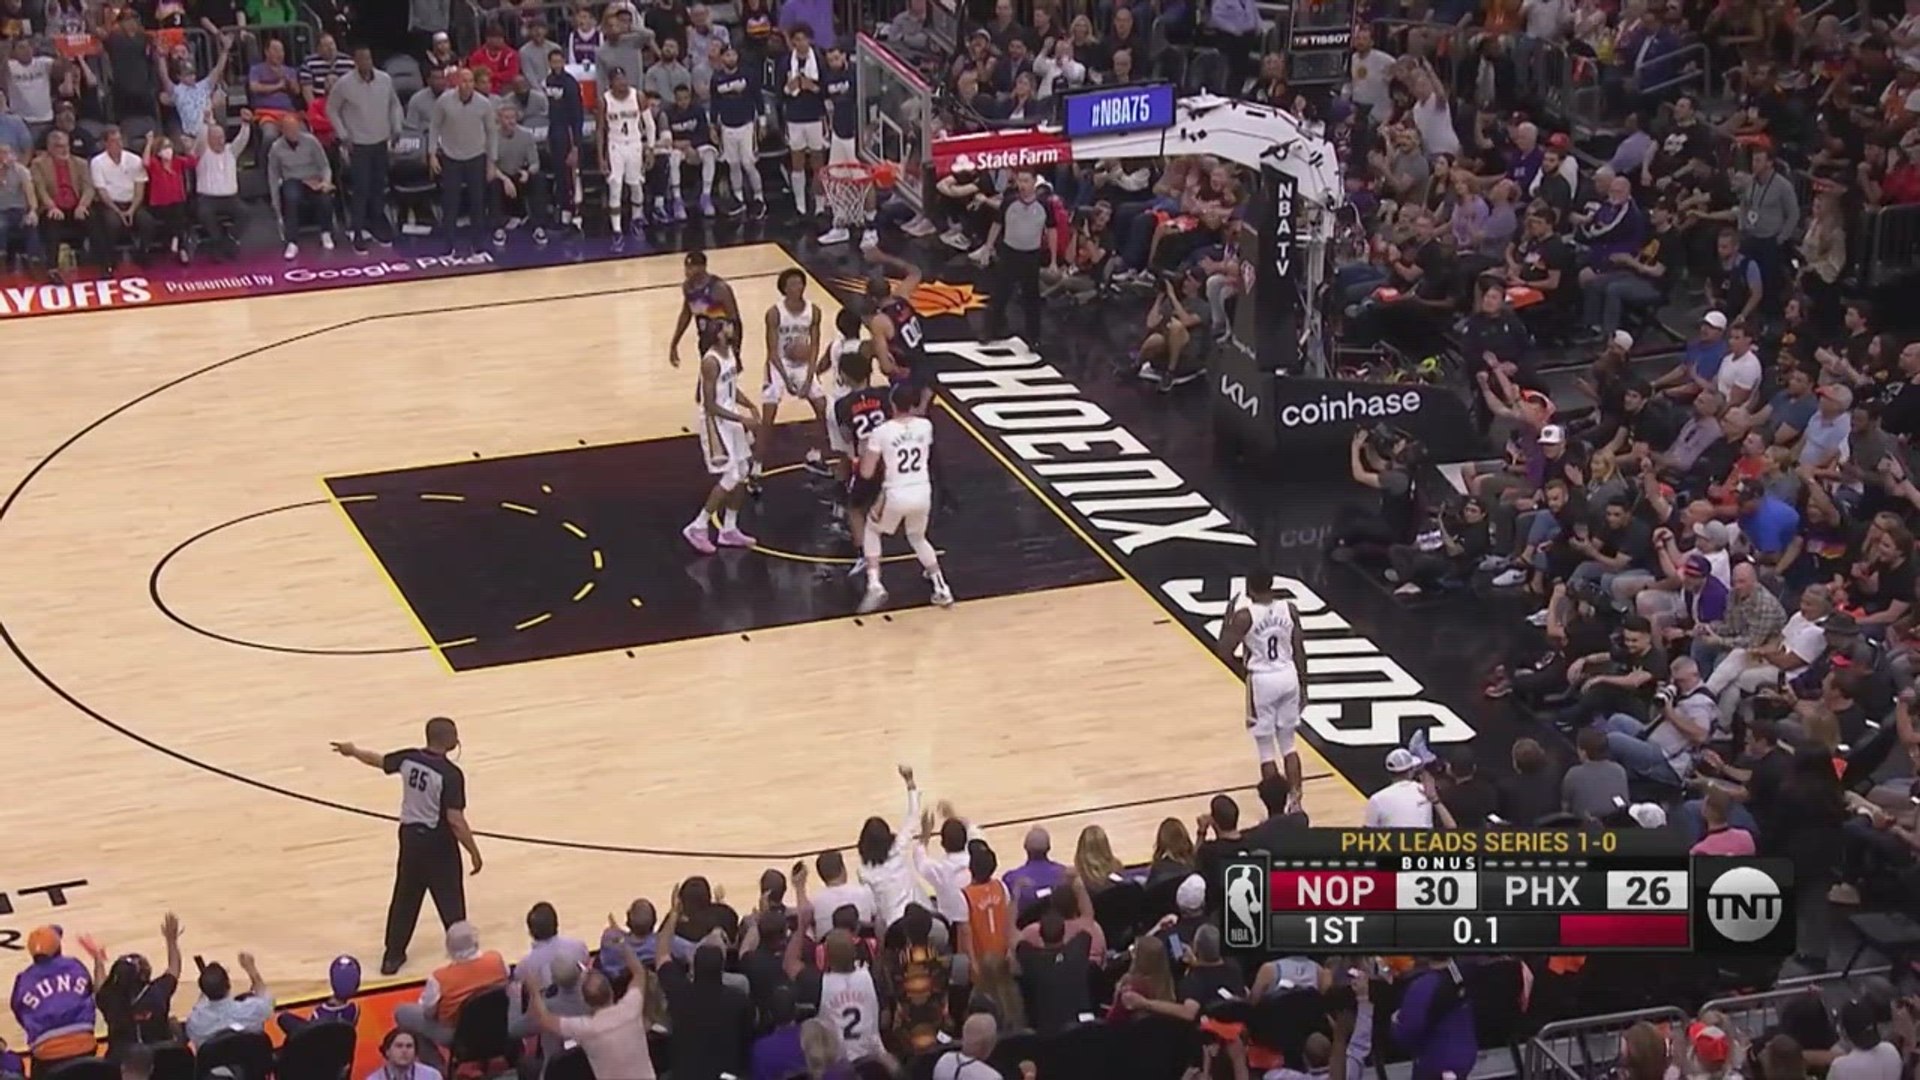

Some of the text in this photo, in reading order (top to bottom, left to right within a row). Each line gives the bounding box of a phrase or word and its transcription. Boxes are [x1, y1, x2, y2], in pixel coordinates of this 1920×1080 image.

[1310, 33, 1351, 45] TISSOT
[1091, 95, 1150, 127] #NBA75
[621, 121, 628, 136] 4
[1276, 183, 1293, 276] NBA TV
[165, 274, 253, 294] Presented
[254, 272, 275, 286] by
[284, 262, 410, 283] Google
[416, 251, 494, 270] Pixel
[899, 315, 923, 348] 00
[728, 381, 732, 398] 1
[1281, 390, 1421, 427] coinbase
[897, 447, 921, 474] 22
[924, 336, 1257, 555] PHOENIX
[1268, 635, 1278, 661] 8
[988, 908, 995, 933] 1
[22, 973, 88, 1010] SUNS
[842, 1007, 861, 1040] 2
